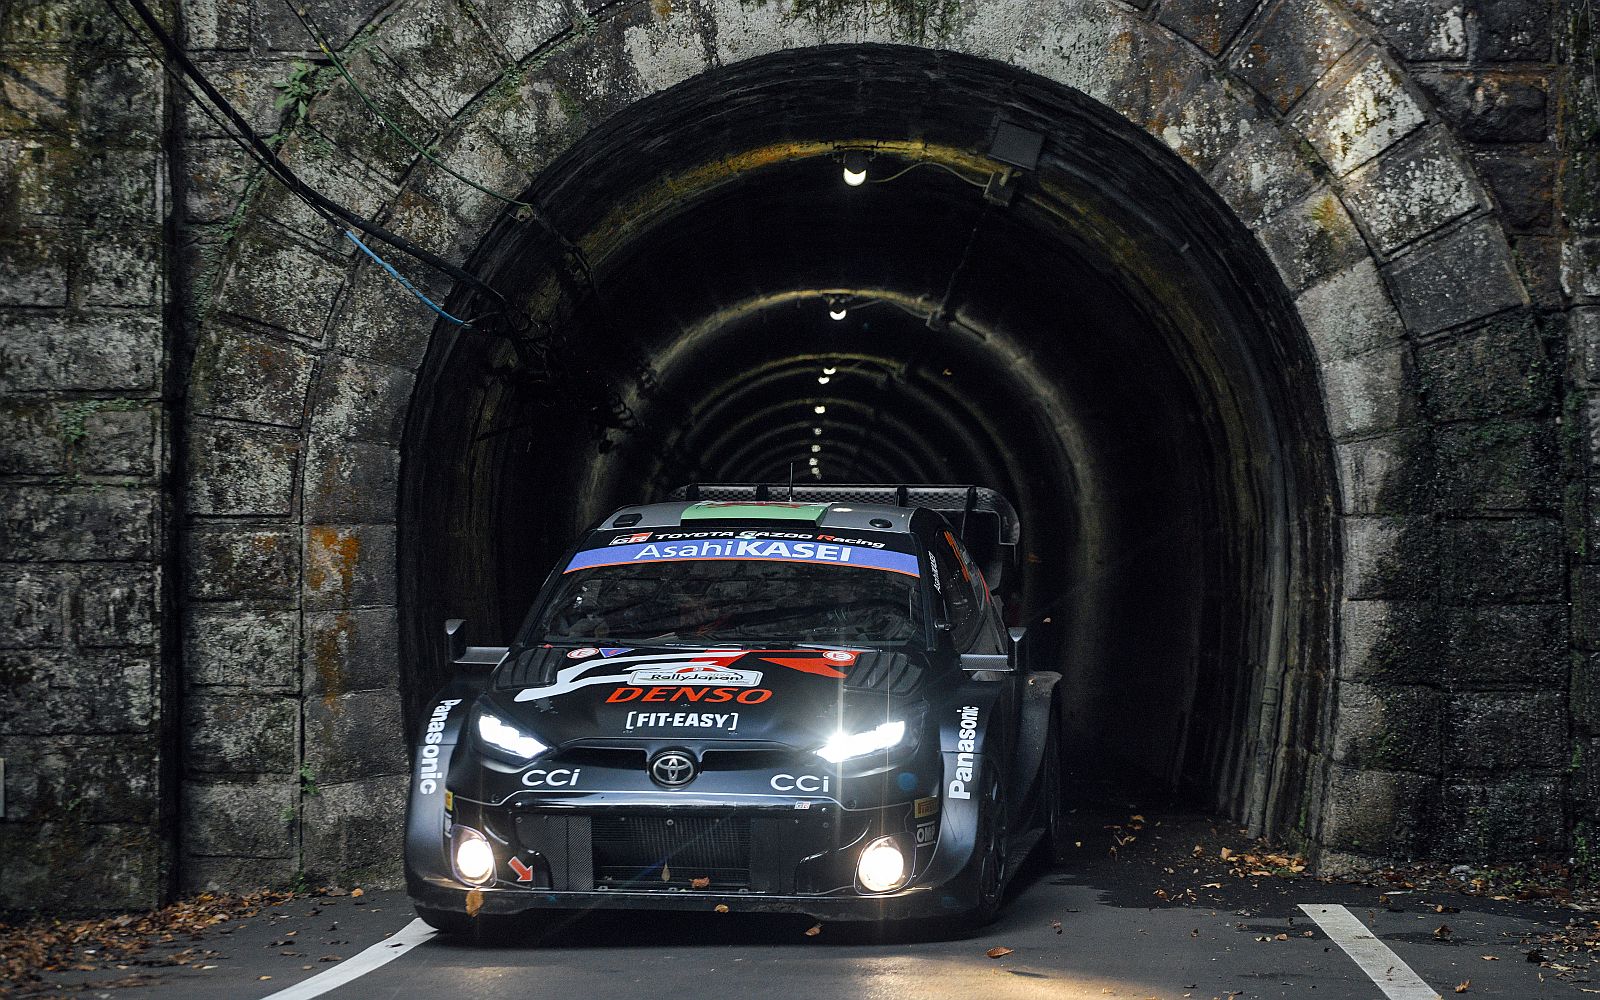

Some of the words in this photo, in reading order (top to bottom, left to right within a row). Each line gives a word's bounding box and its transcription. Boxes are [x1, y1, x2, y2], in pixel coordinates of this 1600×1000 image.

[612, 533, 649, 545] GR
[656, 531, 735, 540] TOYOTA
[740, 530, 813, 539] GAZOO
[816, 534, 886, 549] Racing
[605, 687, 773, 705] DENSO
[420, 699, 462, 794] Panasonic
[949, 706, 979, 800] Panasonic
